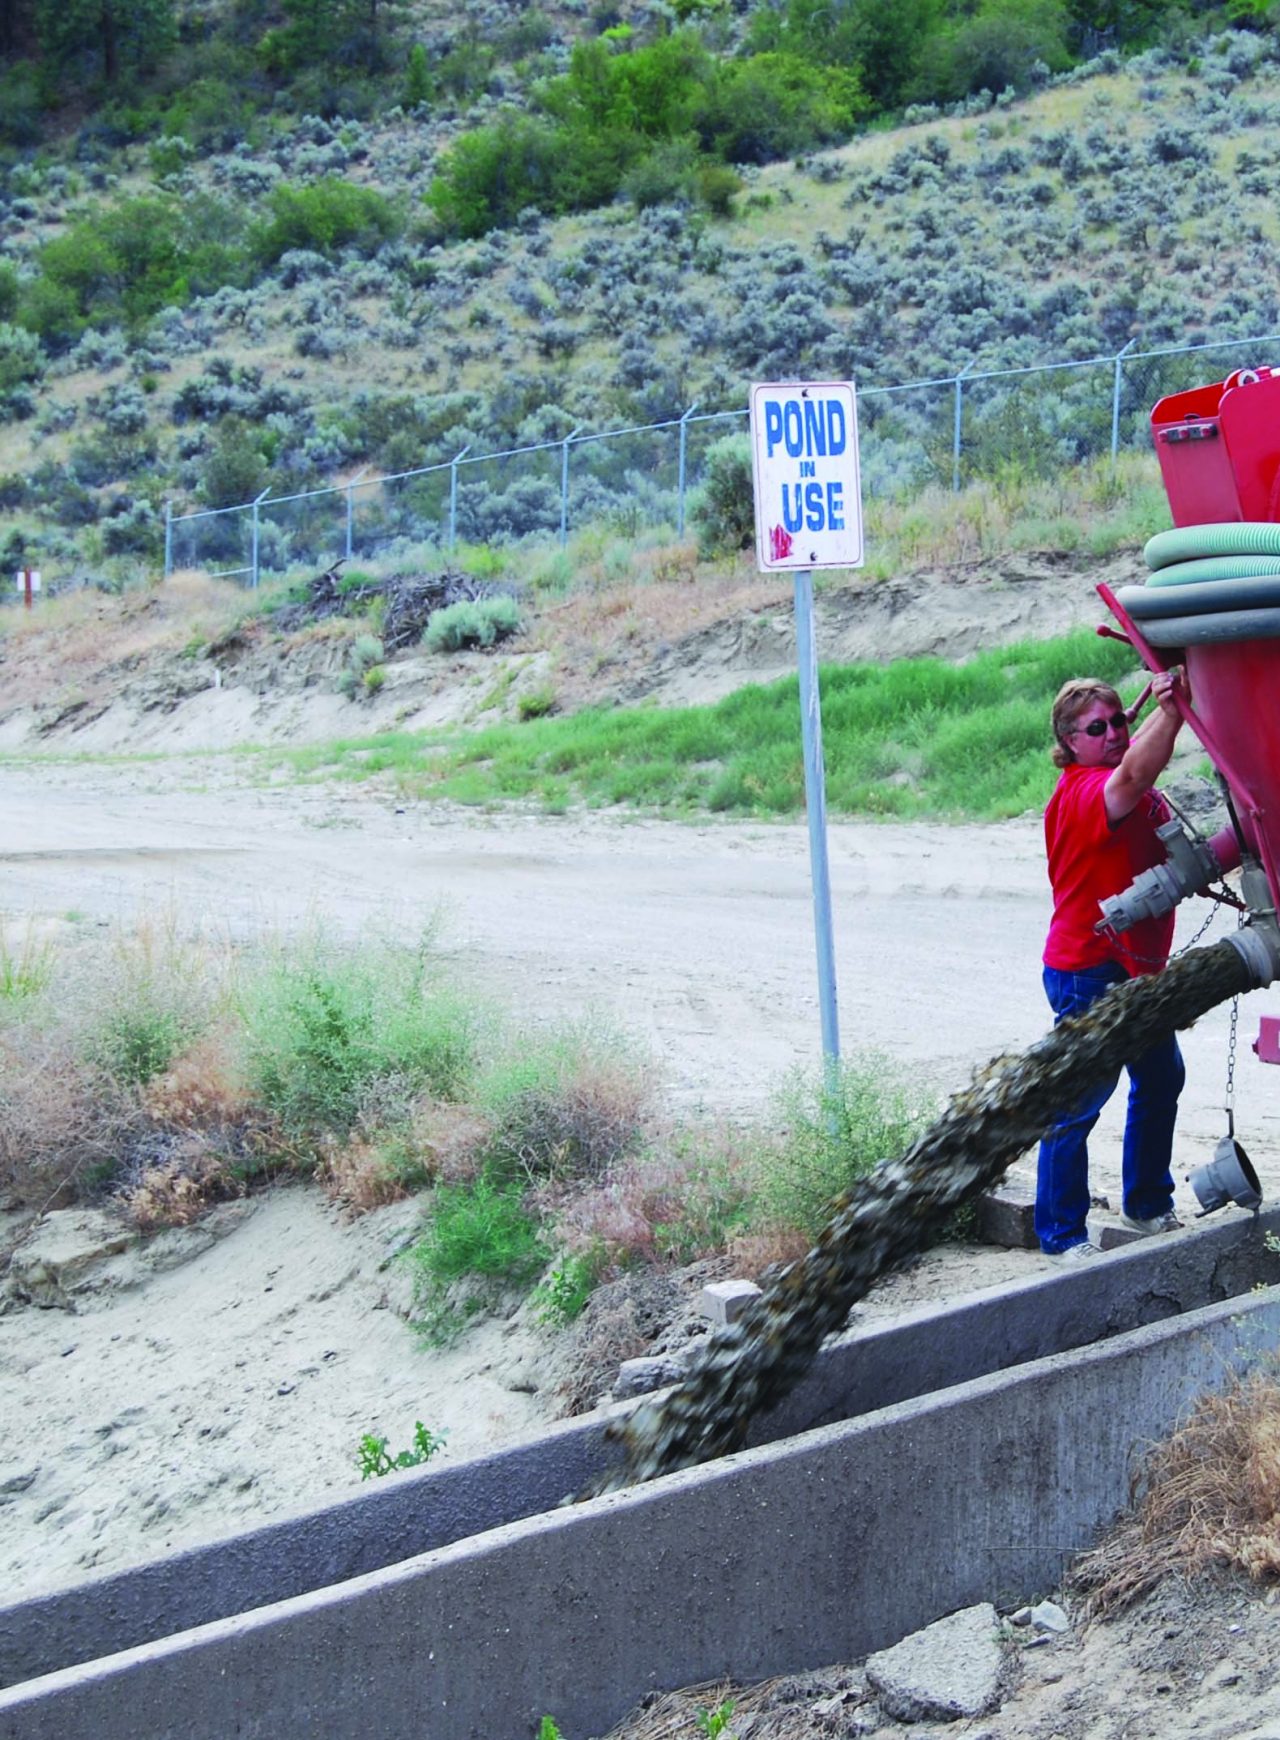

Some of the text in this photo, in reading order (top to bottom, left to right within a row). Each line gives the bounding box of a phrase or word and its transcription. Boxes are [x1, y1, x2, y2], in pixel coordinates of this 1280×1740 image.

[764, 400, 845, 458] POND
[800, 461, 815, 477] IN
[782, 482, 845, 533] USE
